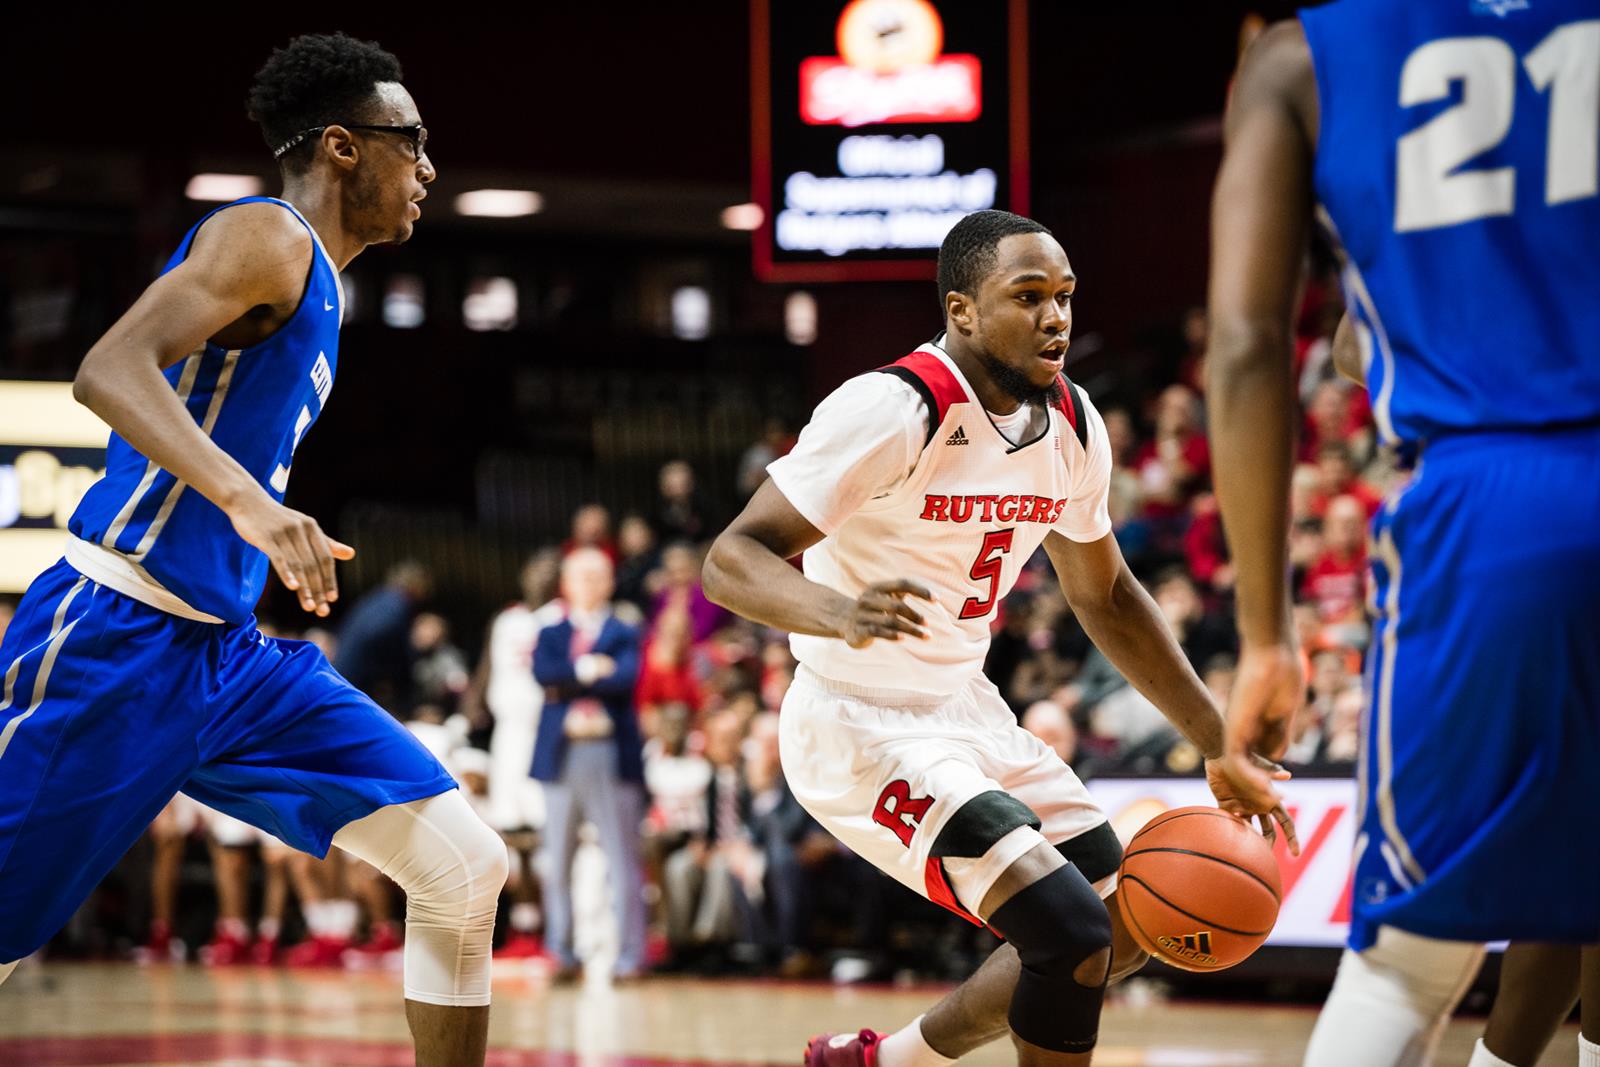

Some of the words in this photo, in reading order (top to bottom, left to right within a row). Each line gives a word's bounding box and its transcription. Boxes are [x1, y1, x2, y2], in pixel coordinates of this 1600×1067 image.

[1394, 18, 1600, 234] 21
[919, 494, 1068, 525] RUTGERS
[957, 527, 1015, 620] 5
[872, 779, 936, 849] R
[1157, 935, 1217, 965] adidas
